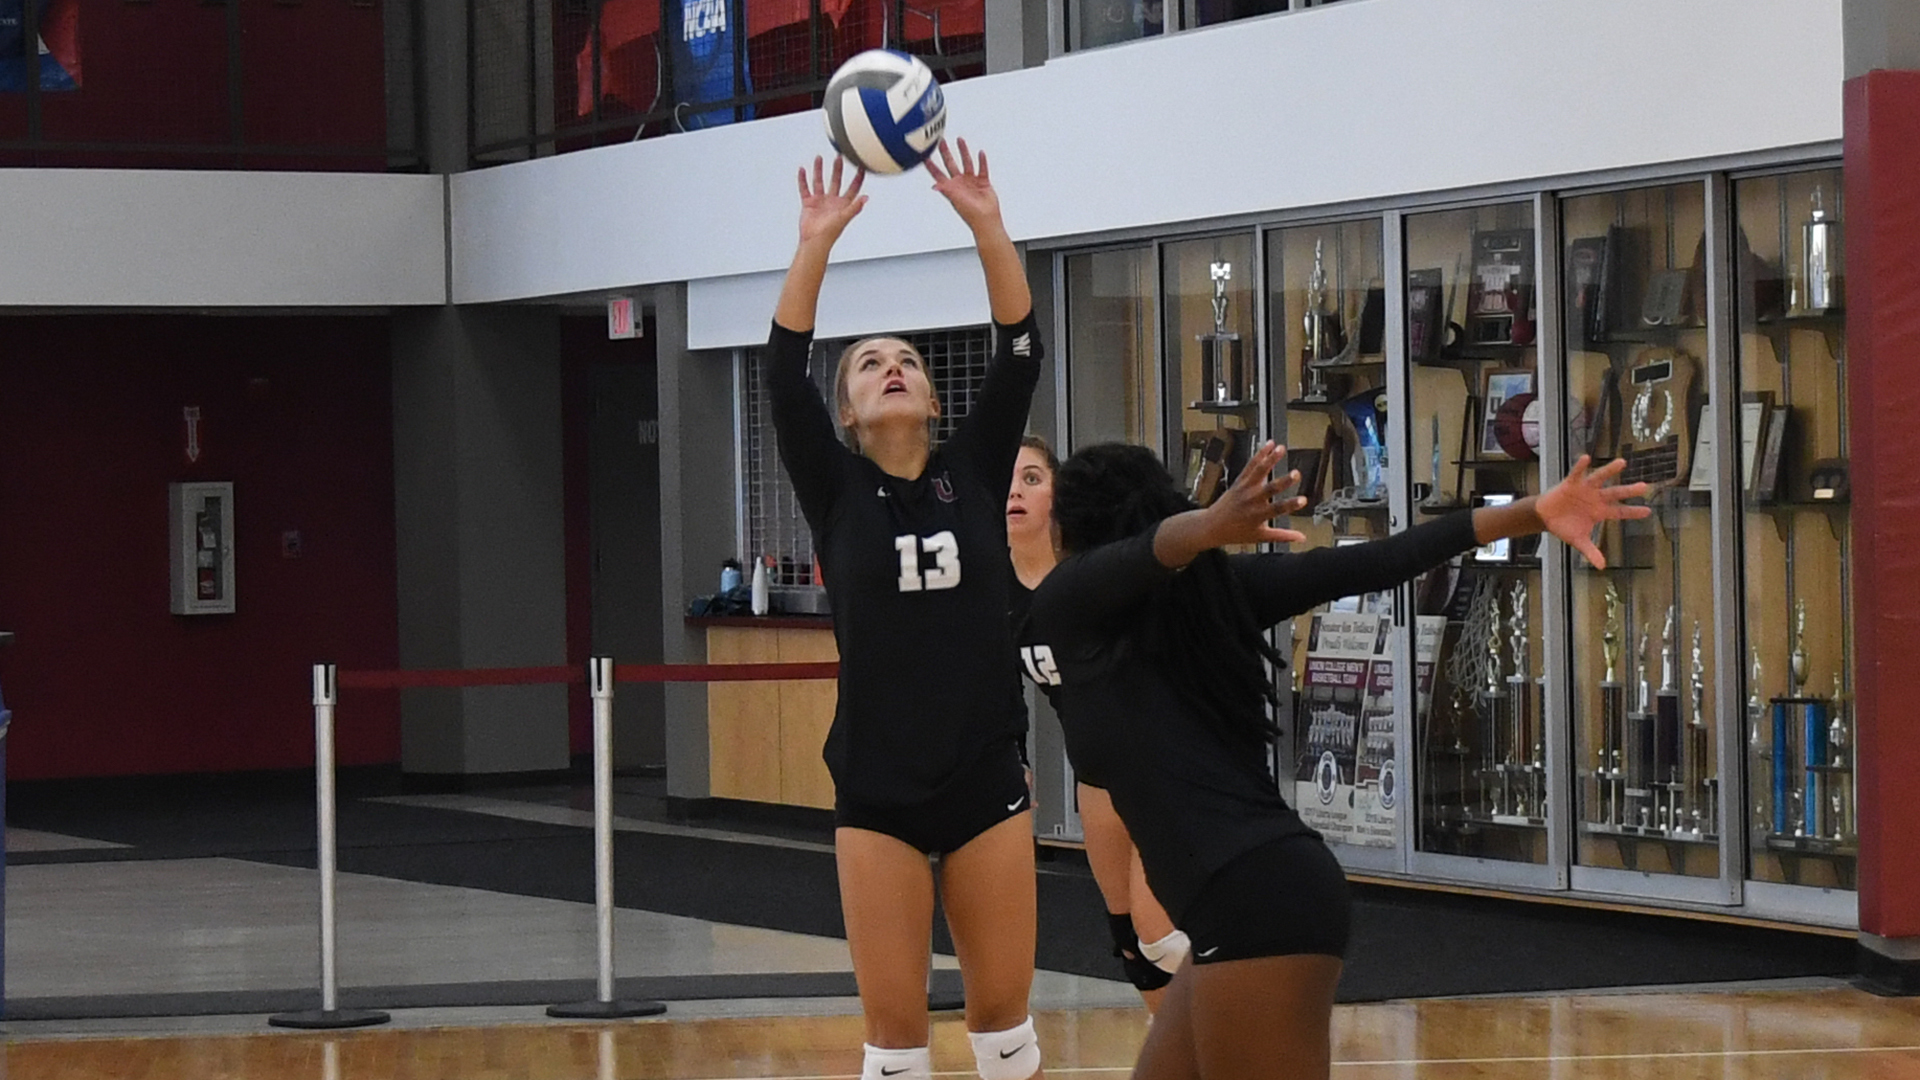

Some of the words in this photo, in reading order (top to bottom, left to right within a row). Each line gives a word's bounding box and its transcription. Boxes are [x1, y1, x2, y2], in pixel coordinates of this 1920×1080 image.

[683, 0, 727, 42] NCAA
[894, 530, 962, 593] 13
[1020, 643, 1062, 687] 12
[1312, 673, 1342, 683] BASKETBALL
[1325, 661, 1346, 672] COLLEGE
